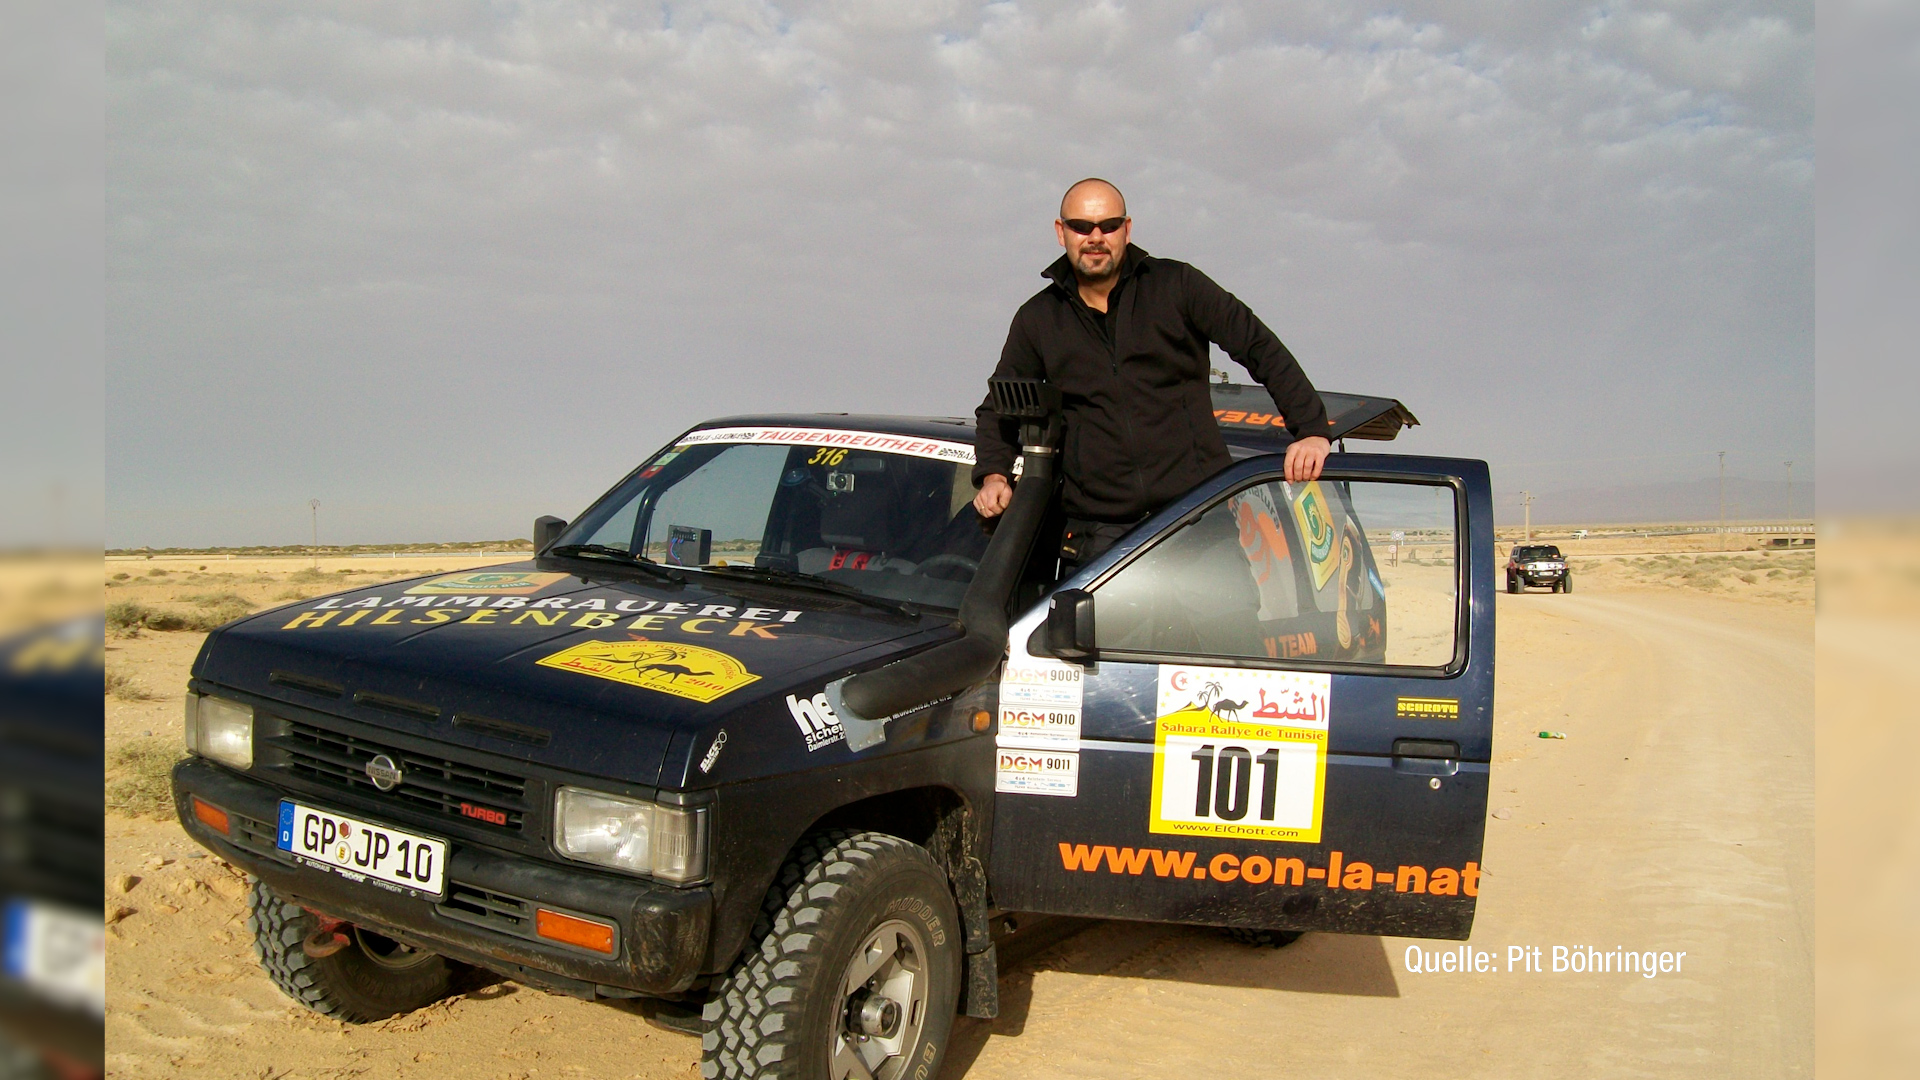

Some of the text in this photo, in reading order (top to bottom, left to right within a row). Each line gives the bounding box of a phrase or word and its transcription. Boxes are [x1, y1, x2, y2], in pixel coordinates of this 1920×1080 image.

[756, 430, 939, 455] TAUBENREUTHER
[807, 447, 848, 466] 316
[312, 596, 802, 623] LAMMBRAUEREI
[281, 609, 785, 639] HILSENBECK
[1278, 632, 1317, 658] TEAM
[683, 678, 726, 691] 2010
[1005, 668, 1080, 683] DGM 9009
[786, 692, 840, 735] he
[1397, 702, 1458, 713] SCHROTH
[1003, 711, 1075, 727] DGM 9010
[1160, 721, 1324, 742] Sahara Rallye de Tunisie
[367, 766, 398, 780] NISSAN
[1000, 755, 1070, 771] DGM 9011
[1191, 744, 1280, 821] 101
[460, 802, 507, 825] TURBO
[283, 830, 289, 842] D
[1173, 823, 1299, 837] www.ElChott.com
[303, 813, 432, 883] GP JP 10
[884, 897, 946, 948] MUDDER
